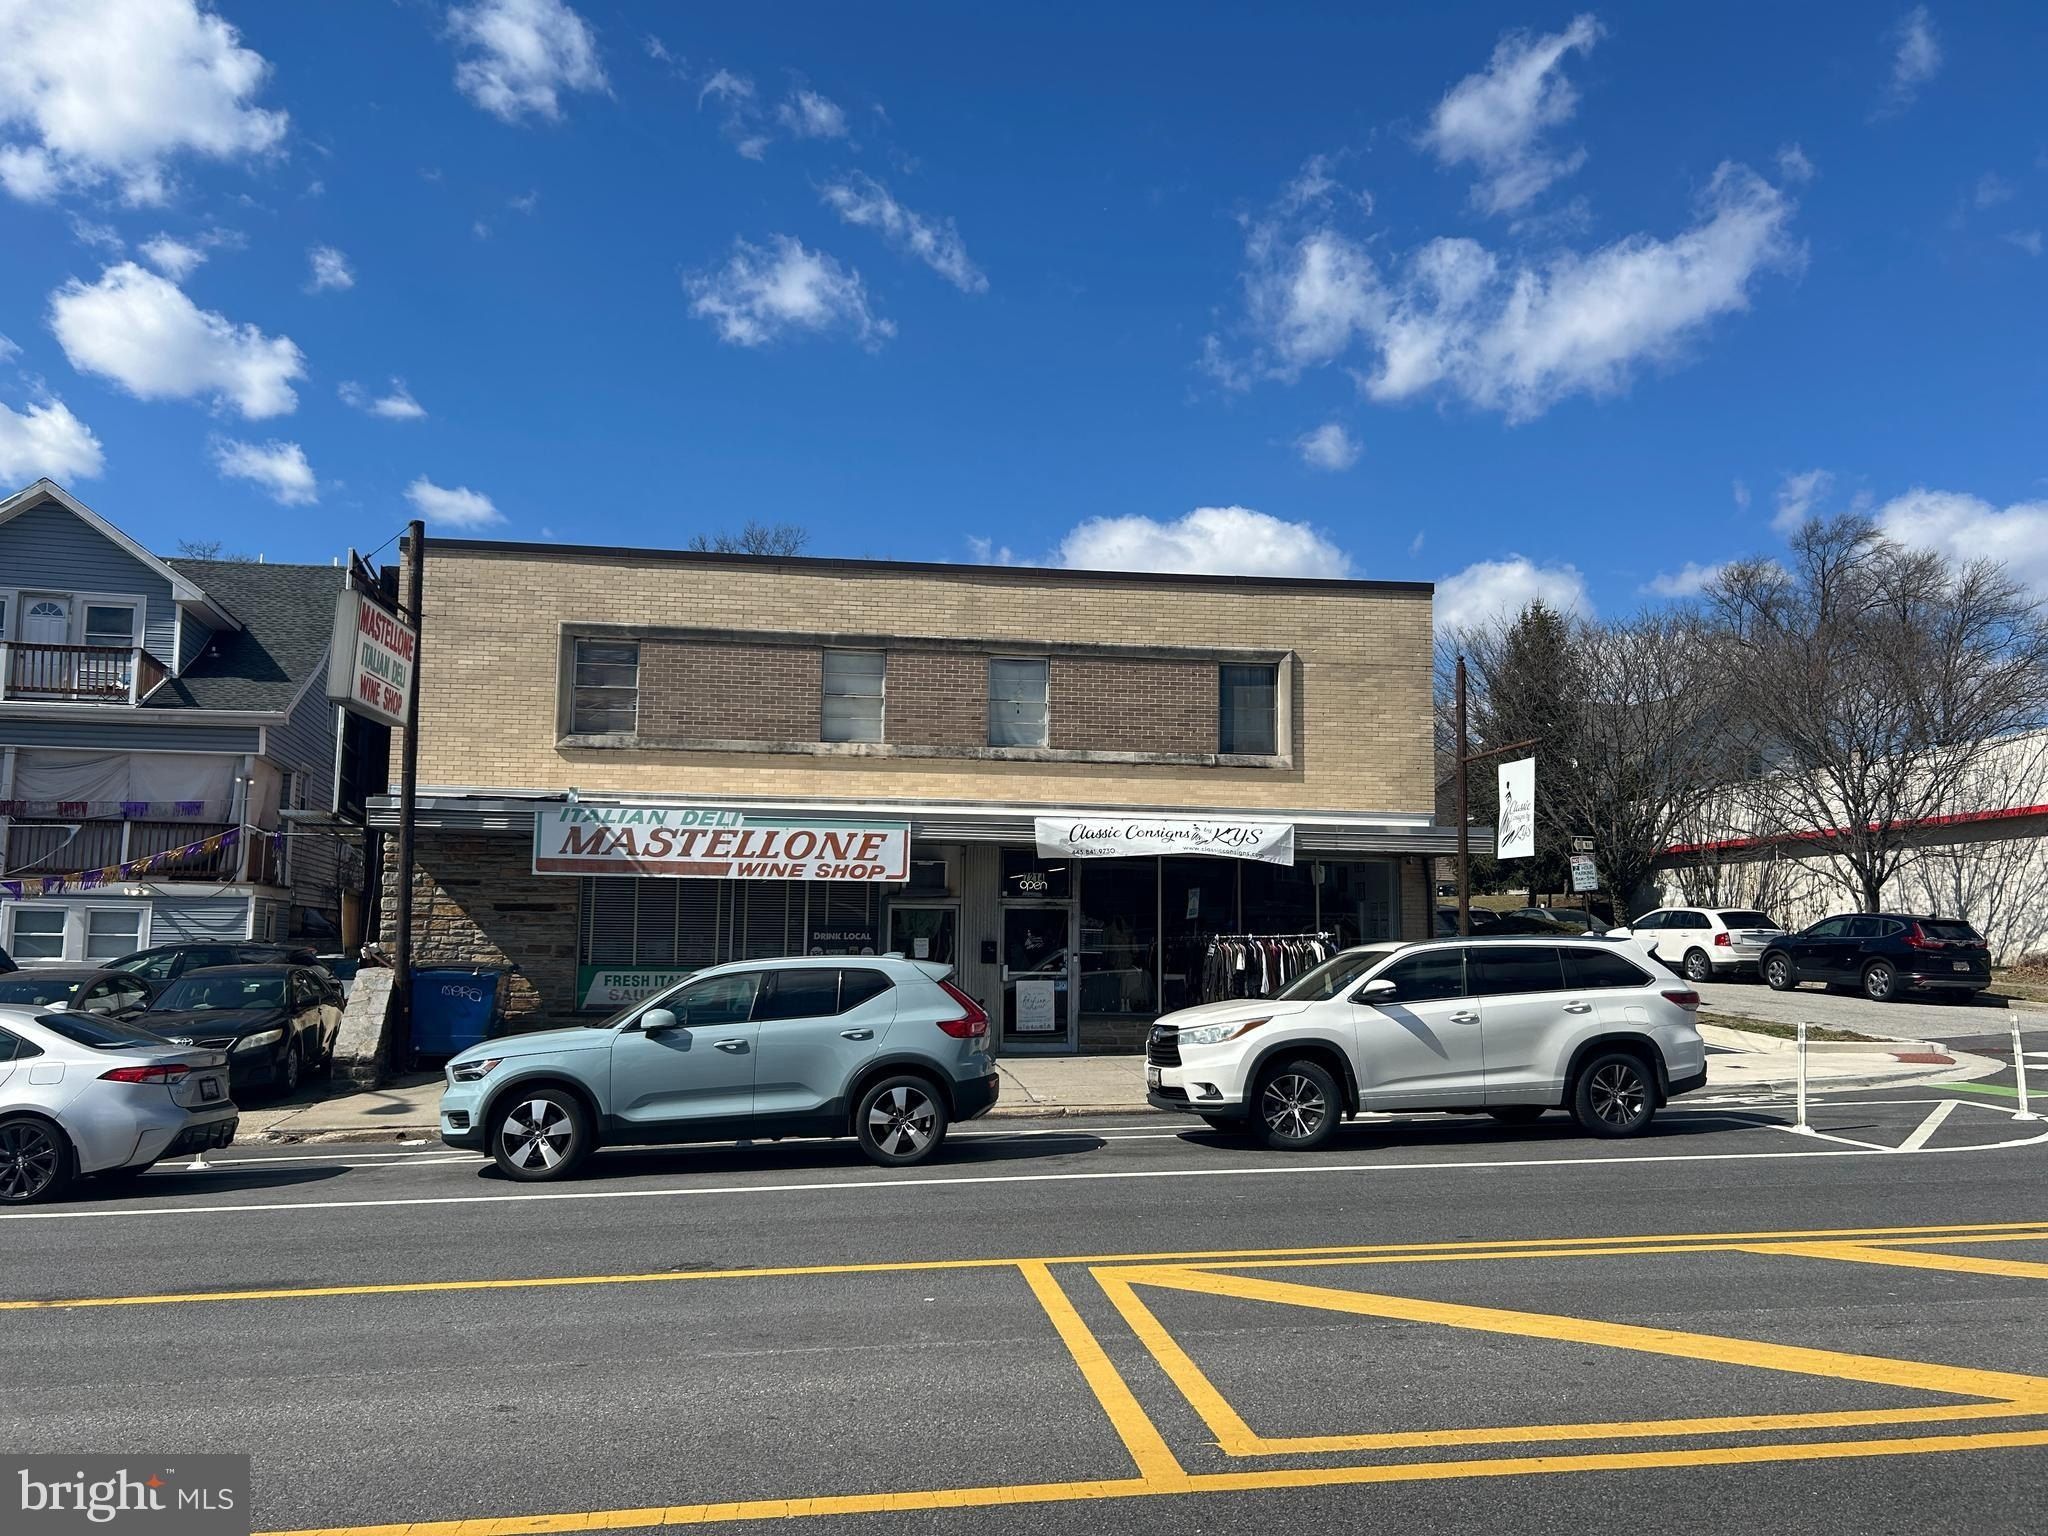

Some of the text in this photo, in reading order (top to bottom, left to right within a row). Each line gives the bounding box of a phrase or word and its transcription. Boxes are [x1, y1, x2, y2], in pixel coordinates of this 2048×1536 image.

[360, 602, 414, 662] MASTELLONE
[361, 642, 406, 688] ITALIAN DELI
[360, 674, 402, 716] WINE SHOP
[559, 807, 743, 827] ITALIAN DELI
[558, 827, 888, 861] MASTELLONE
[1069, 824, 1122, 843] Classic
[1125, 824, 1190, 843] Consigns
[1212, 828, 1263, 847] KYS
[737, 863, 886, 879] WINE SHOP
[1020, 880, 1047, 891] open
[813, 932, 871, 940] DRINK LOCAL
[604, 975, 681, 987] FRESH ITA
